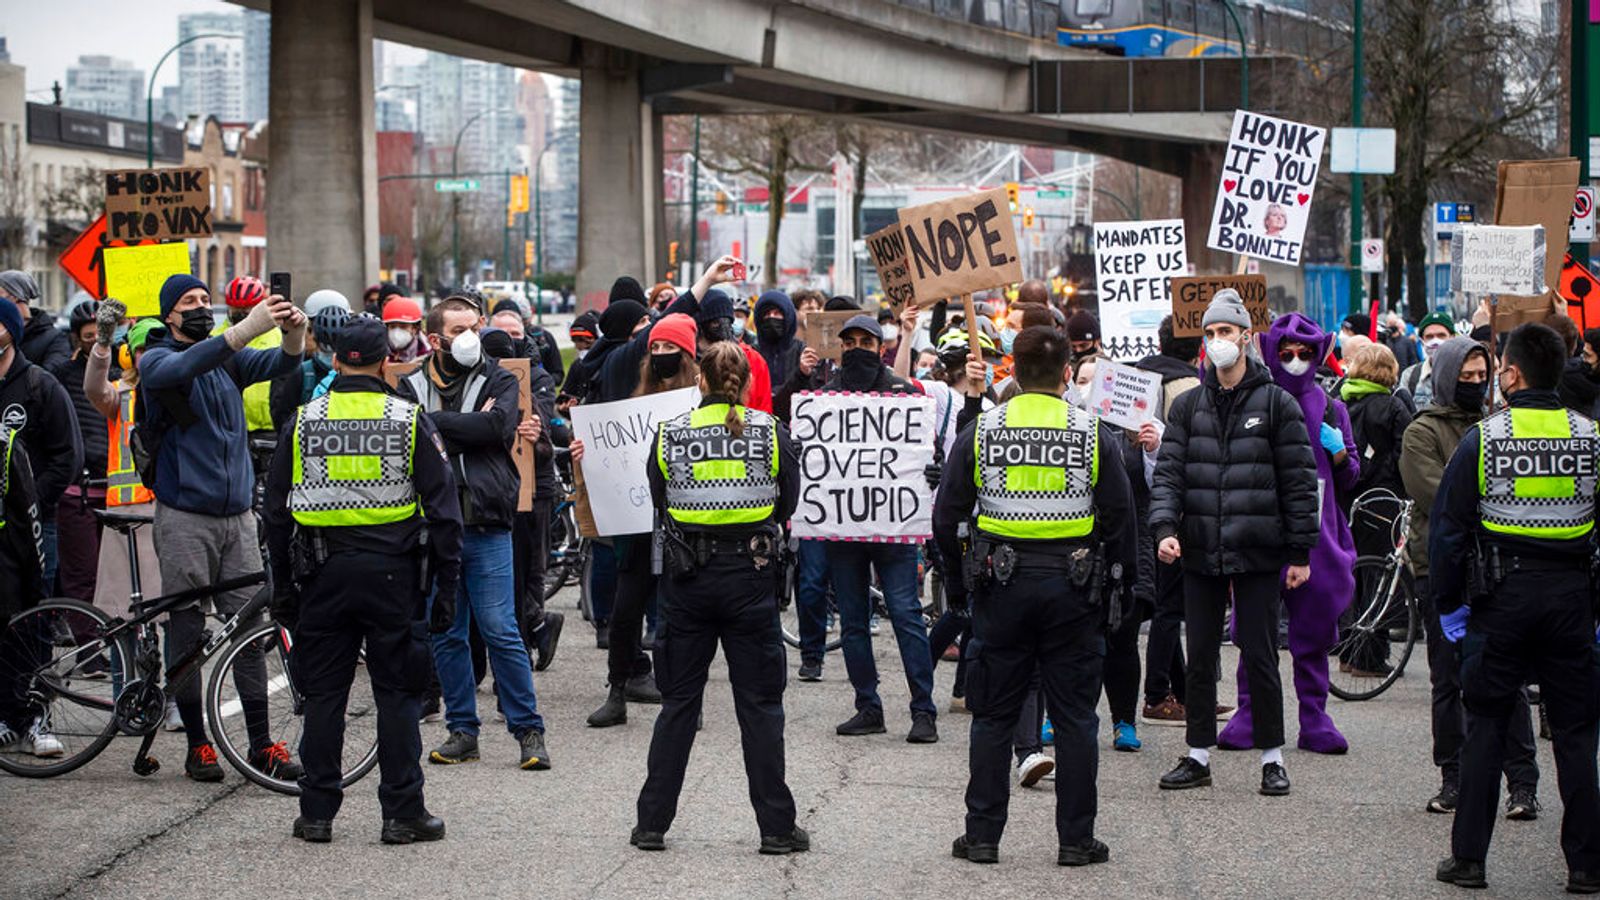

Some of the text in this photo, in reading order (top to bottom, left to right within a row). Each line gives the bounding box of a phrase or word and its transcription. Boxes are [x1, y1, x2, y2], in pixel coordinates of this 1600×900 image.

[1239, 114, 1320, 158] HONK
[1225, 144, 1317, 186] IF YOU
[107, 171, 202, 195] HONK
[1235, 176, 1297, 206] LOVE
[1218, 197, 1252, 229] DR.
[1440, 206, 1452, 221] T
[870, 230, 906, 267] HON
[905, 199, 1016, 279] NOPE.
[1096, 226, 1183, 249] MANDATES
[1217, 227, 1300, 262] BONNIE
[1100, 251, 1183, 274] KEEP US
[888, 281, 915, 307] SCIEN
[1180, 281, 1219, 303] GET
[1175, 309, 1205, 329] WE
[309, 420, 400, 432] VANCOUVER
[590, 411, 656, 449] HONK
[796, 398, 922, 443] SCIENCE
[307, 434, 401, 454] POLICE
[671, 426, 762, 442] VANCOUER
[990, 429, 1082, 444] VANCOUVER
[1496, 439, 1591, 452] VANCOUVER
[671, 439, 764, 460] POLICE
[989, 443, 1083, 466] POLICE
[802, 444, 898, 481] OVER
[1495, 454, 1592, 475] POLICE
[803, 484, 919, 525] STUPID
